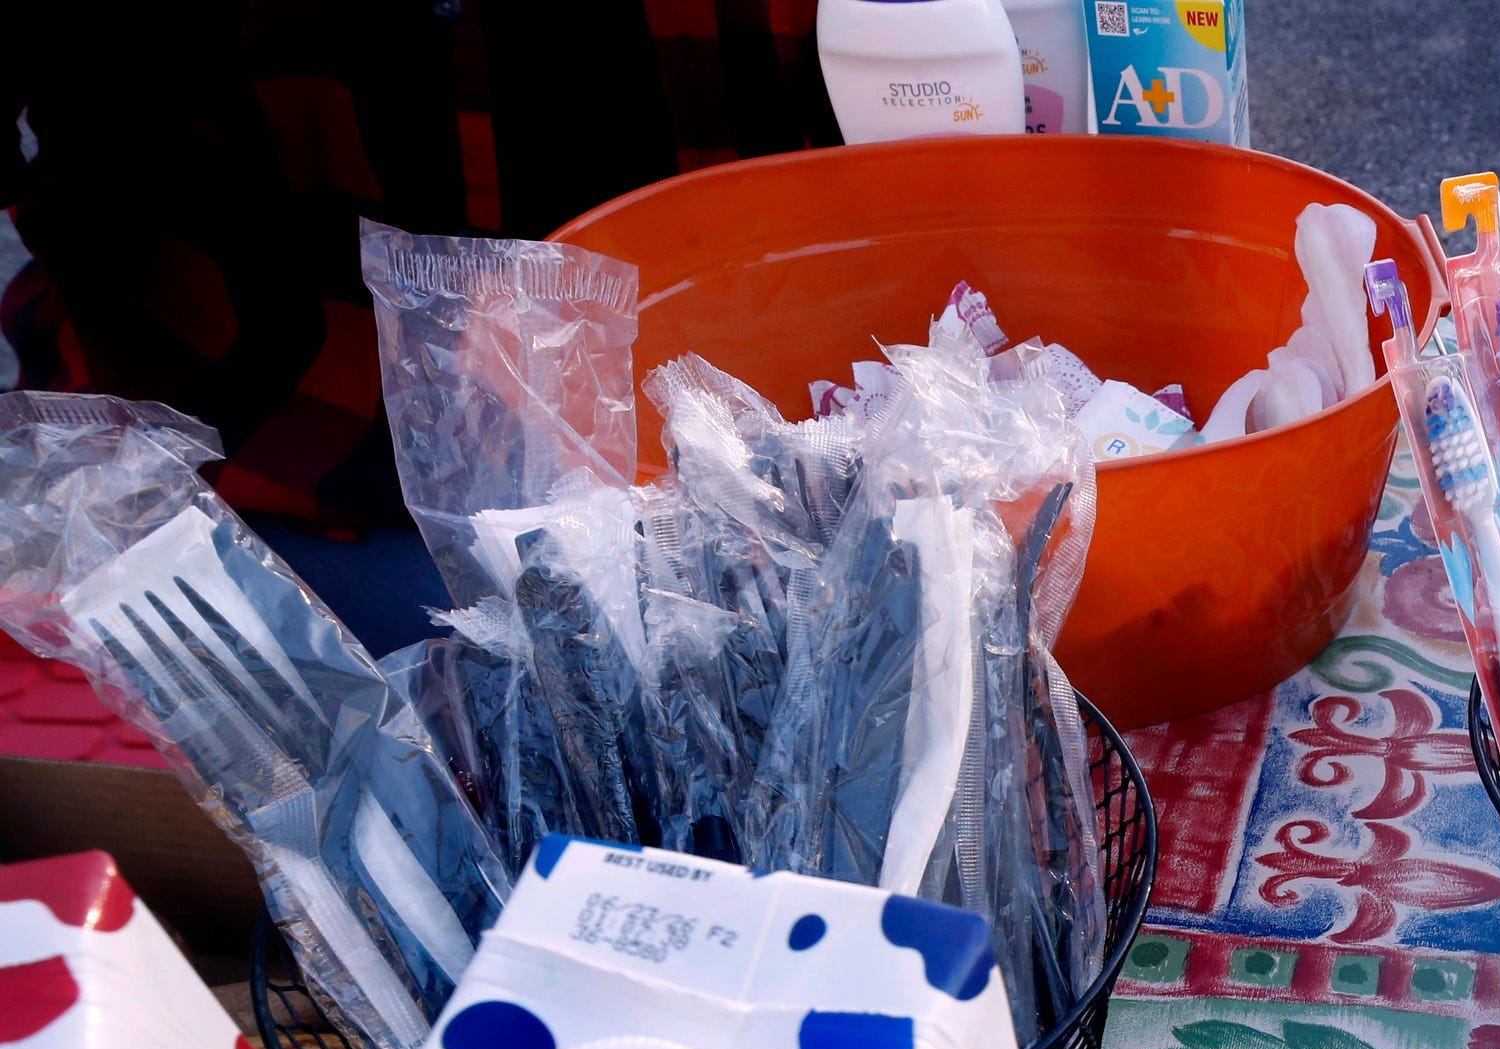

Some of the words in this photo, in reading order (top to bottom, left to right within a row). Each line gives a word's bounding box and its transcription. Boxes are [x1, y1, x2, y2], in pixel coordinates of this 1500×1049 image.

[1186, 10, 1218, 27] NEW
[889, 81, 951, 97] STUDIO
[882, 95, 961, 107] SELECTION
[953, 110, 975, 122] SUN
[604, 852, 645, 868] BEST
